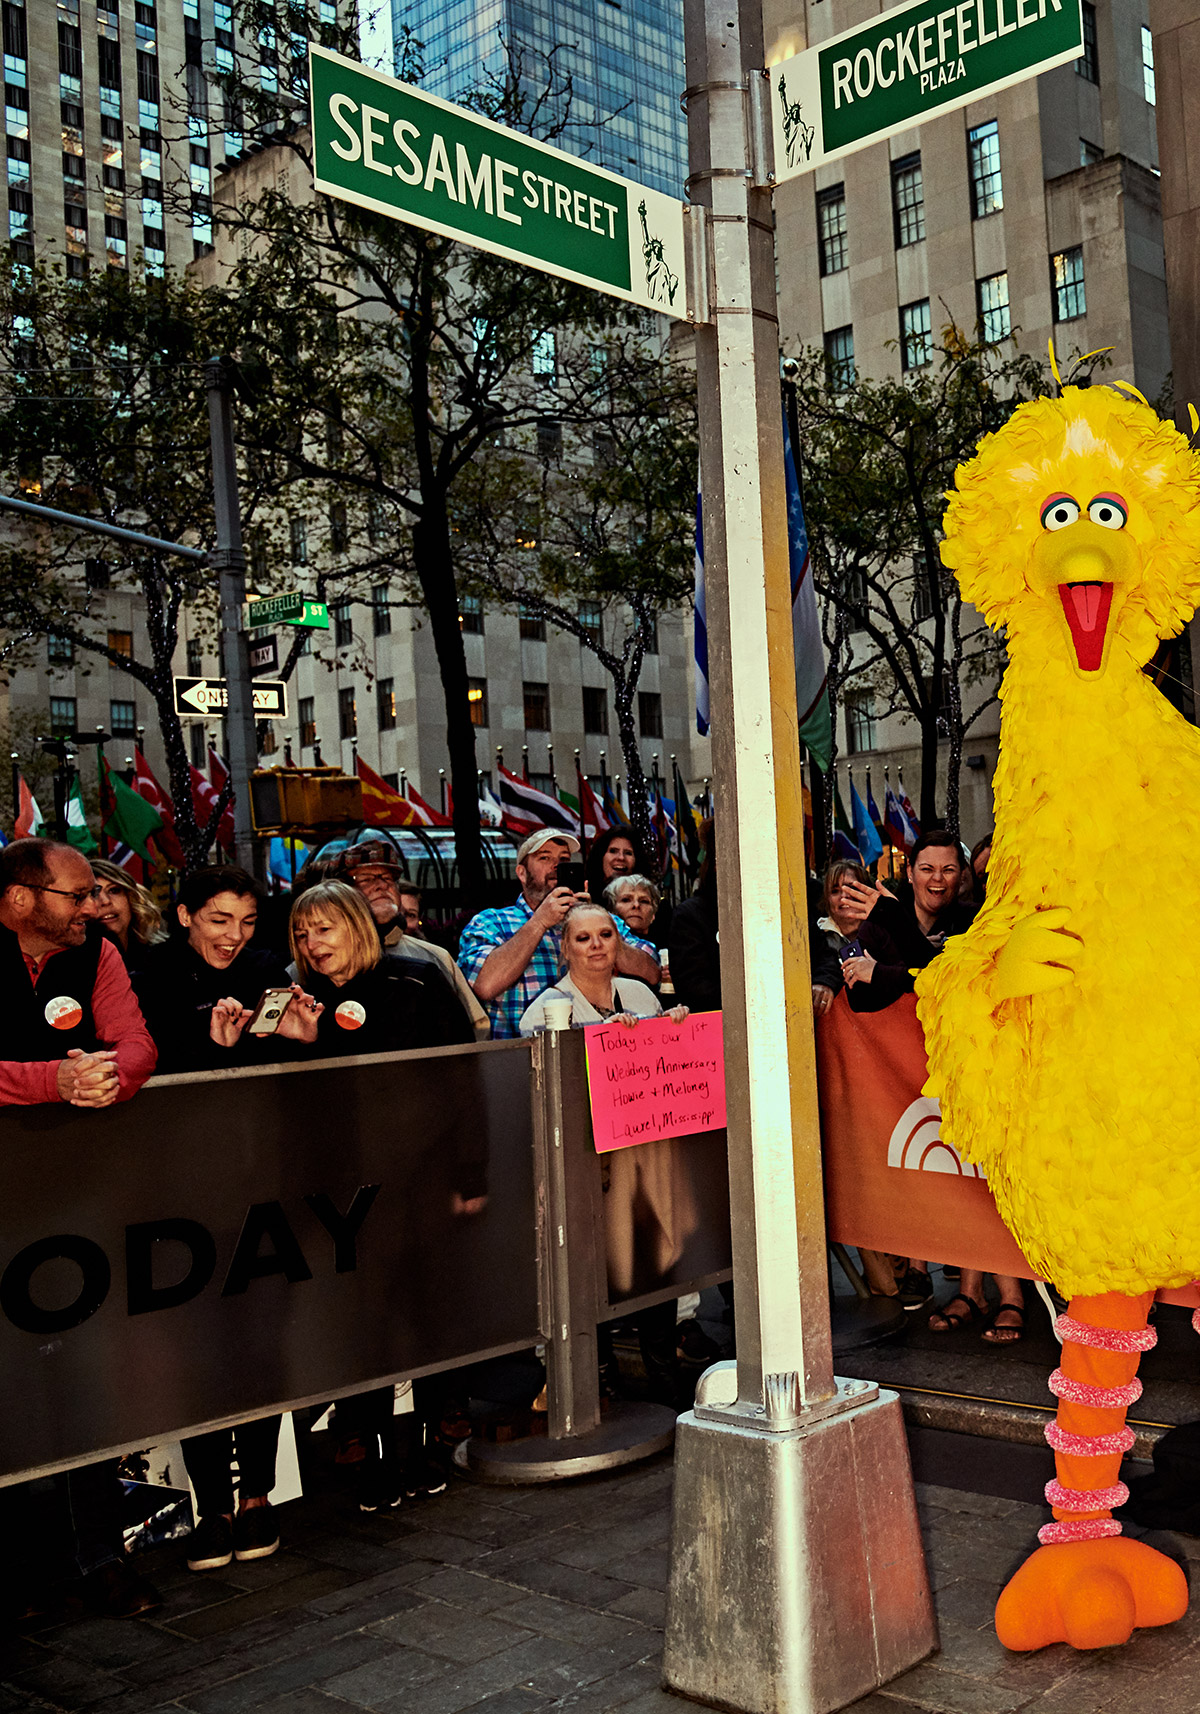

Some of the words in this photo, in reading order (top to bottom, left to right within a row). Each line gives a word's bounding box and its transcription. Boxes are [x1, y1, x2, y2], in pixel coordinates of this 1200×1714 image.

[920, 57, 967, 95] PLAZA
[329, 92, 522, 226] SESAME
[521, 169, 619, 240] STREET
[251, 593, 301, 617] ROCKEFELLER
[310, 604, 323, 616] ST
[593, 1031, 637, 1053] Today
[643, 1032, 654, 1046] is
[661, 1033, 681, 1045] our
[691, 1022, 708, 1041] 1st
[606, 1061, 650, 1082] Wedding
[656, 1056, 717, 1075] Anniversary
[612, 1088, 645, 1107] Howie
[663, 1081, 709, 1100] Meloney
[0, 1183, 382, 1334] ODAY
